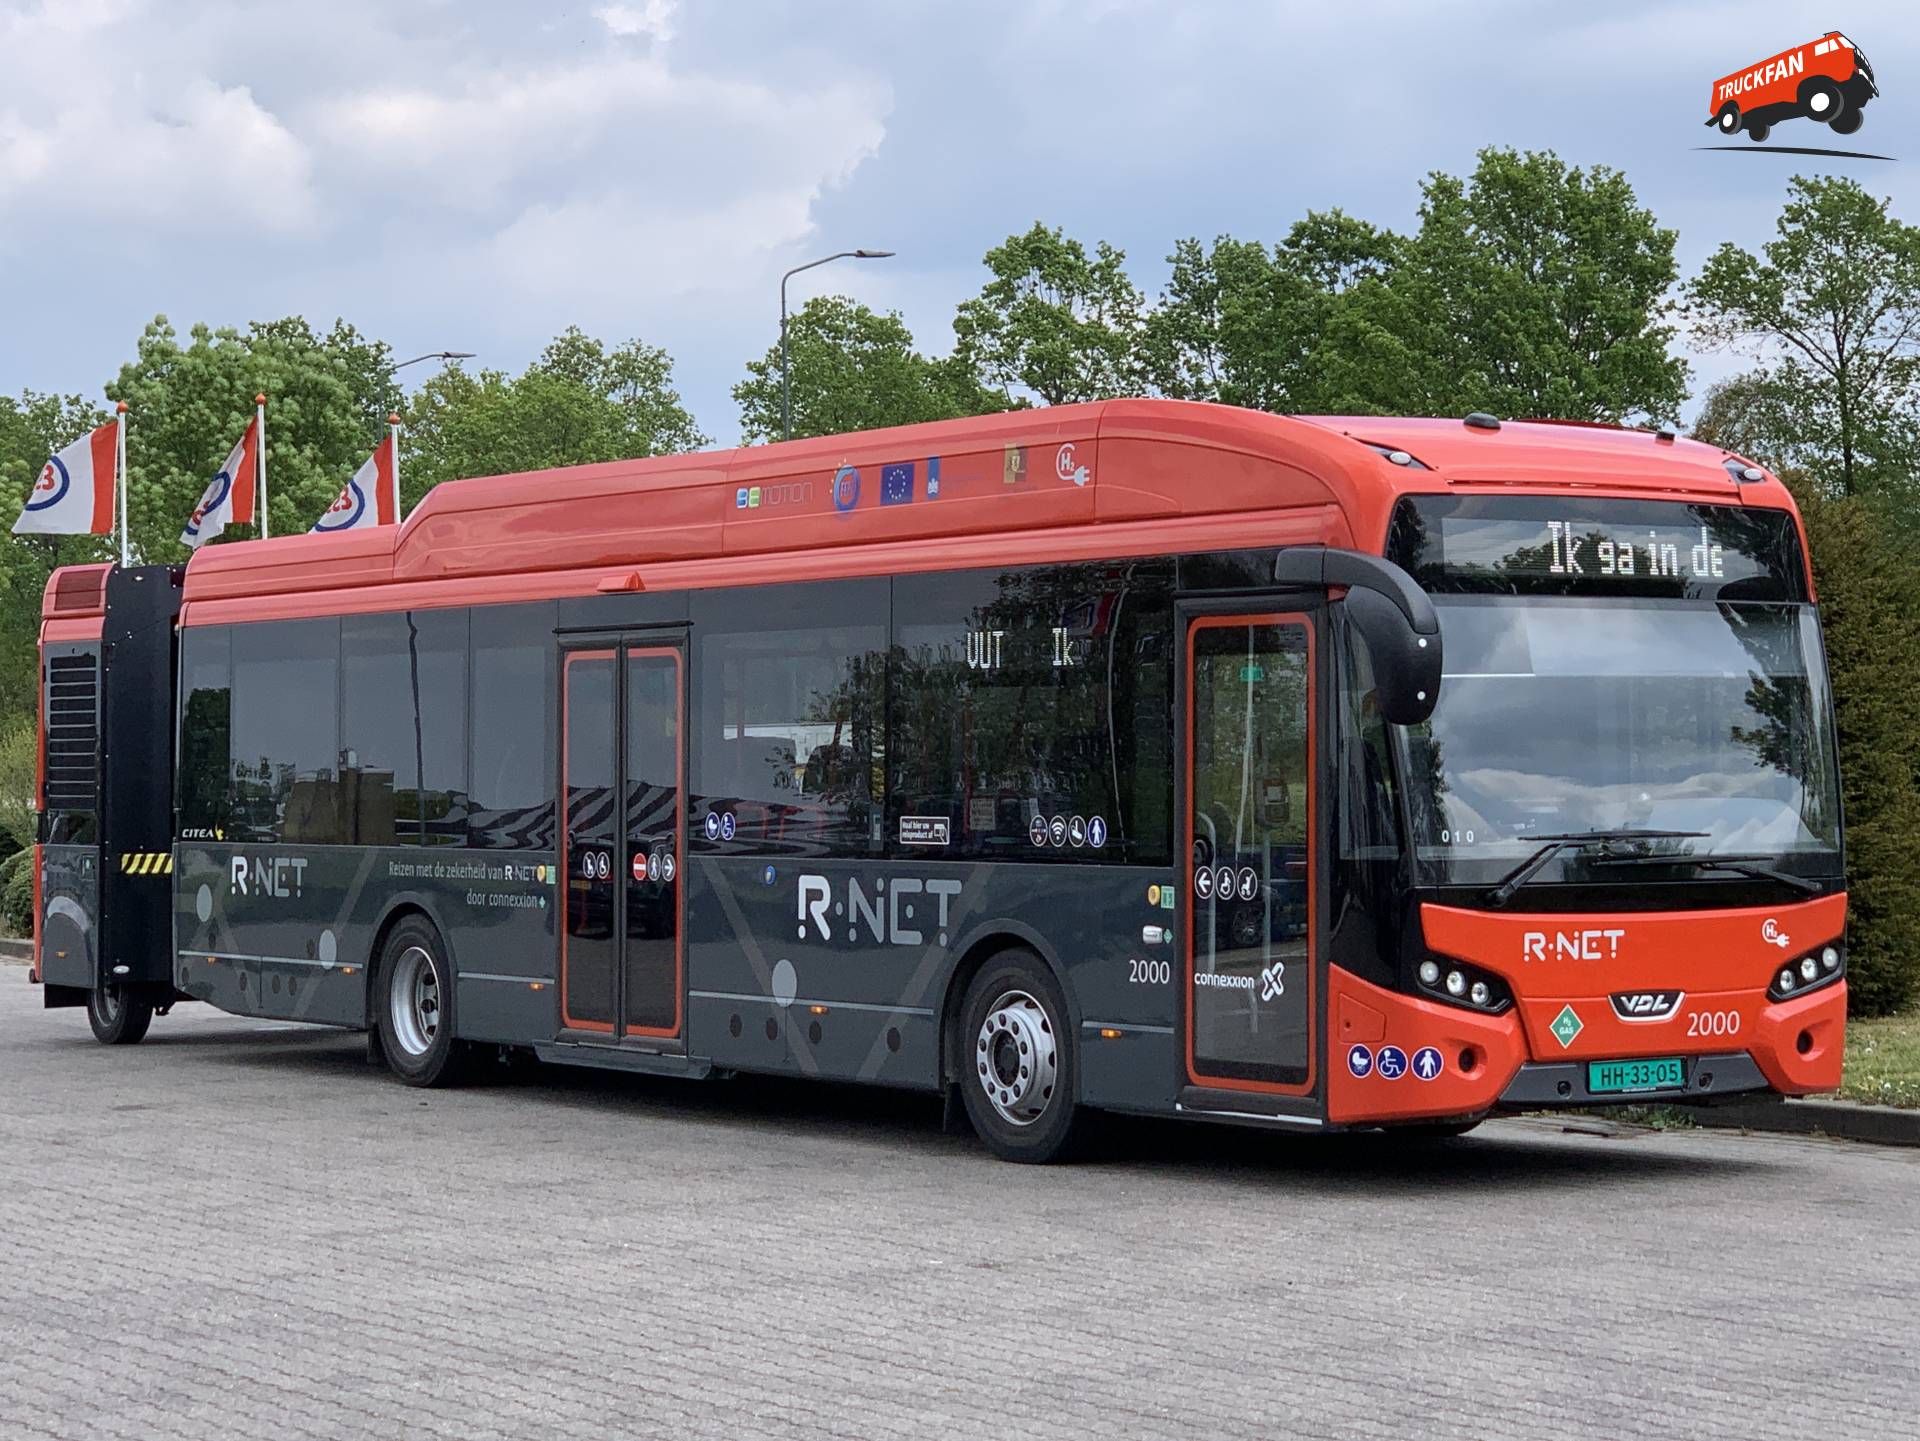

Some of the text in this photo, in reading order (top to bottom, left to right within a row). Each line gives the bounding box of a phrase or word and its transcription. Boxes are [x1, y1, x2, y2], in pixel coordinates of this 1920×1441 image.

[1547, 521, 1584, 574] Ik
[1598, 542, 1634, 575] ga
[1648, 531, 1679, 576] in
[1053, 627, 1074, 666] Ik
[182, 828, 214, 839] CITEA
[388, 861, 414, 877] Reizen
[416, 865, 433, 878] met
[434, 861, 446, 878] de
[446, 862, 486, 880] zekerheid
[487, 865, 503, 880] van
[466, 887, 538, 909] door connexxion
[1128, 959, 1171, 985] 2000
[1194, 972, 1255, 989] connexxion
[1619, 994, 1670, 1013] VDL
[1687, 1010, 1741, 1037] 2000
[1600, 1063, 1679, 1087] HH-33-05
